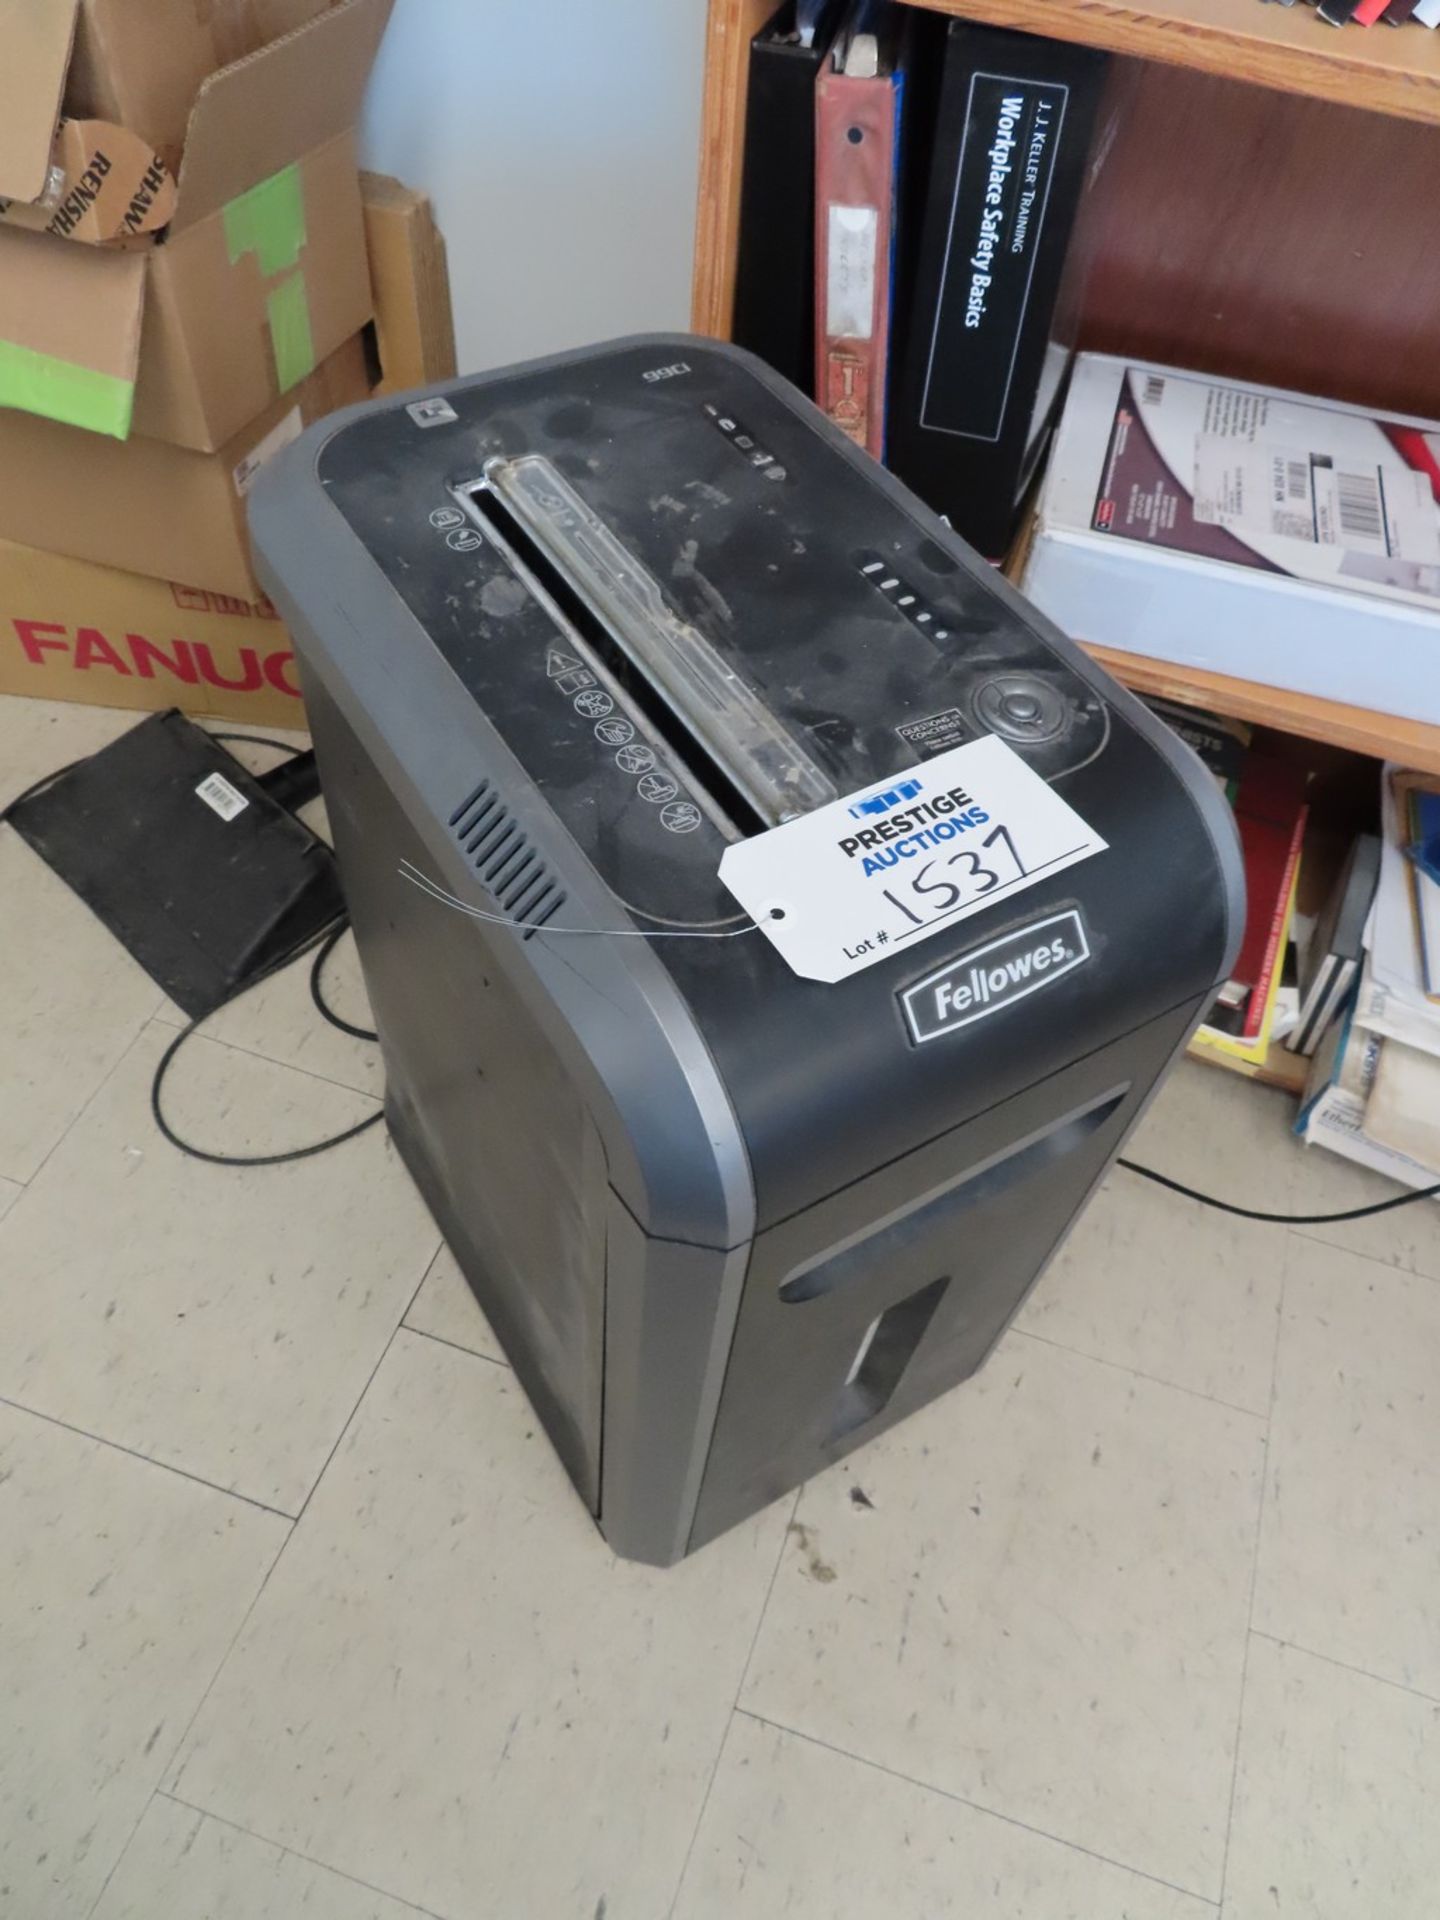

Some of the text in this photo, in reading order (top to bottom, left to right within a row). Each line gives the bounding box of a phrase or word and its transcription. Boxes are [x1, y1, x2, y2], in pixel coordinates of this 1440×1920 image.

[965, 97, 1024, 328] Workplace Safety Basics
[1012, 100, 1052, 254] J. J. KELLER TRAINING
[838, 787, 973, 858] PRESTIGE
[861, 806, 990, 877] AUCTIONS
[883, 824, 1028, 924] 1537
[842, 930, 889, 960] Lot #
